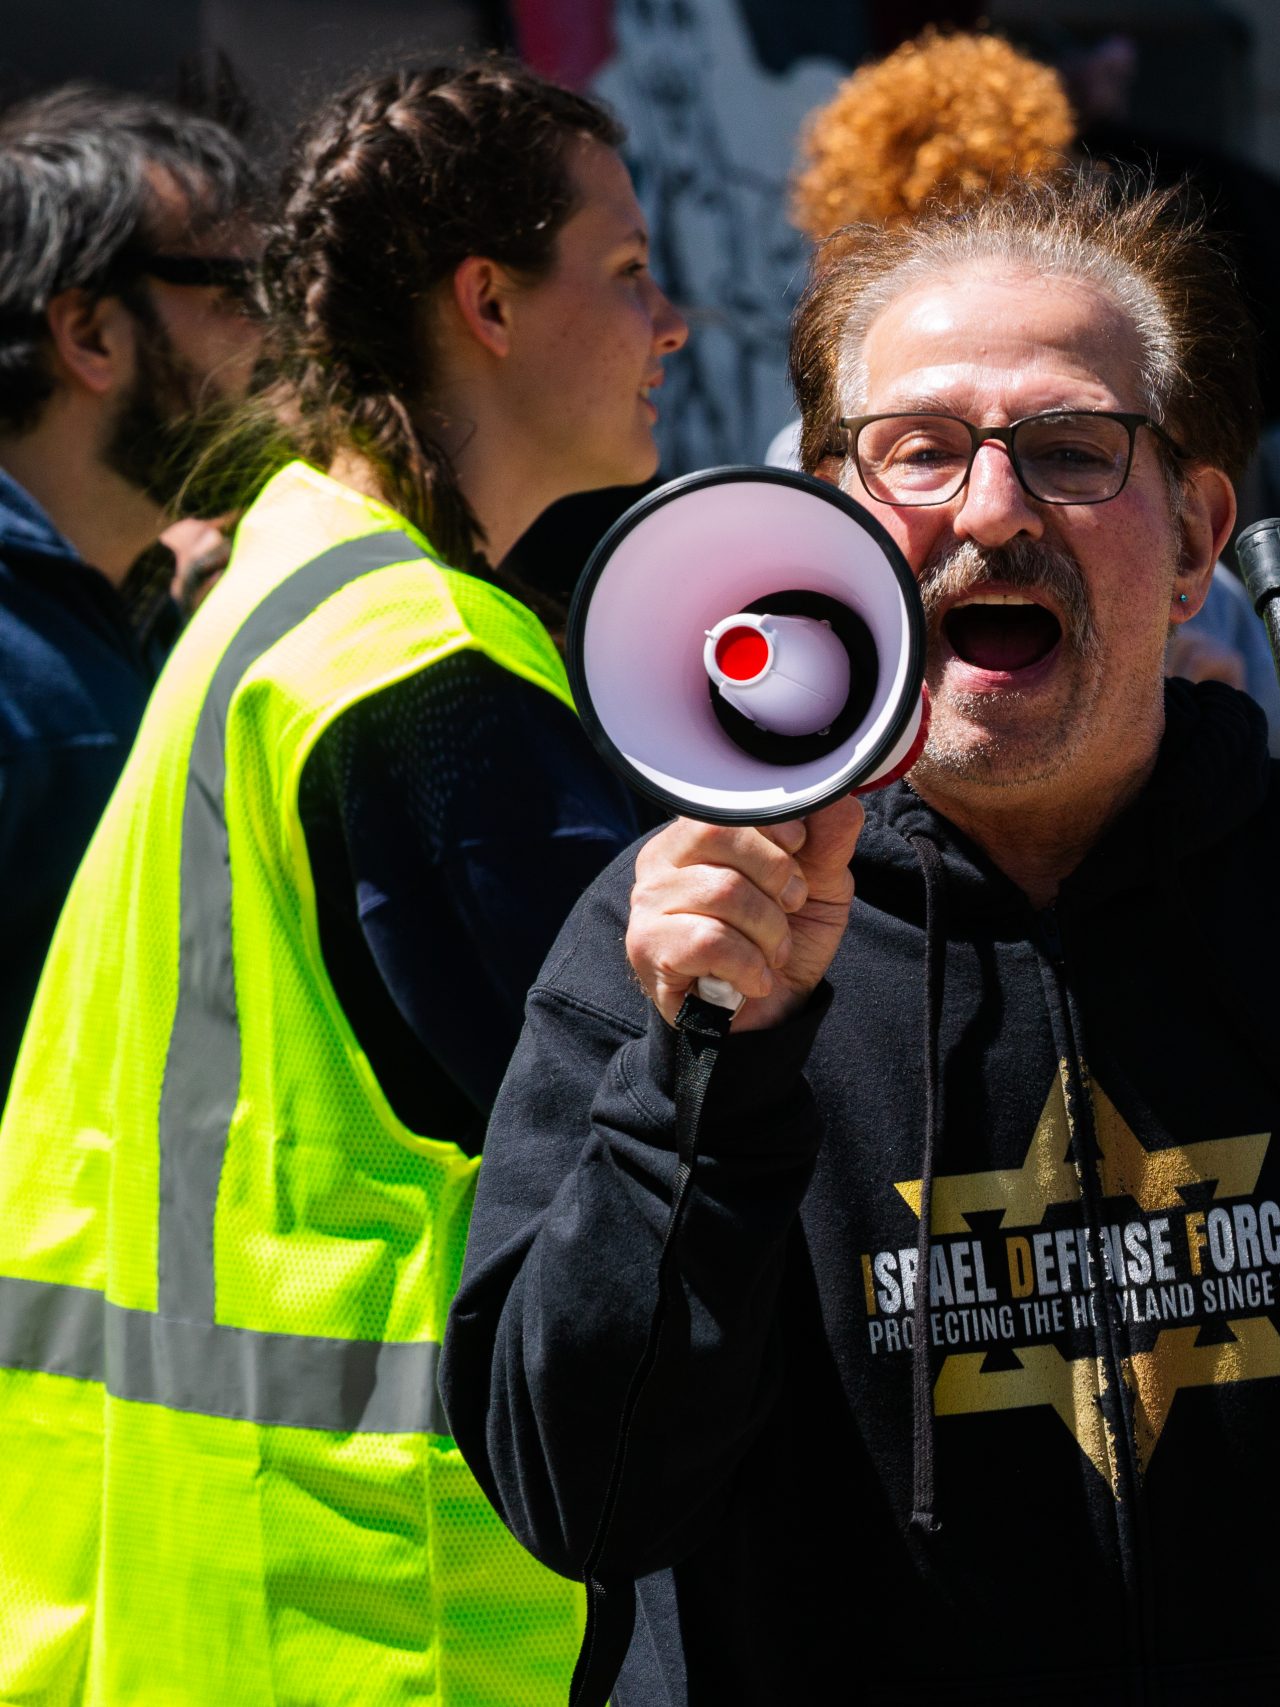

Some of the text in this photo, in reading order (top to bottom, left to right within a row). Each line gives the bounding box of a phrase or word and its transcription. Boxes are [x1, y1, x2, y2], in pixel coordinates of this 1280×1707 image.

[860, 1240, 998, 1315] ISRAEL
[1005, 1217, 1176, 1299] DEFENSE
[868, 1304, 1015, 1354] PROECTING
[1019, 1298, 1065, 1335] THE
[1071, 1283, 1196, 1330] HYLAND
[1202, 1270, 1276, 1314] SINCE
